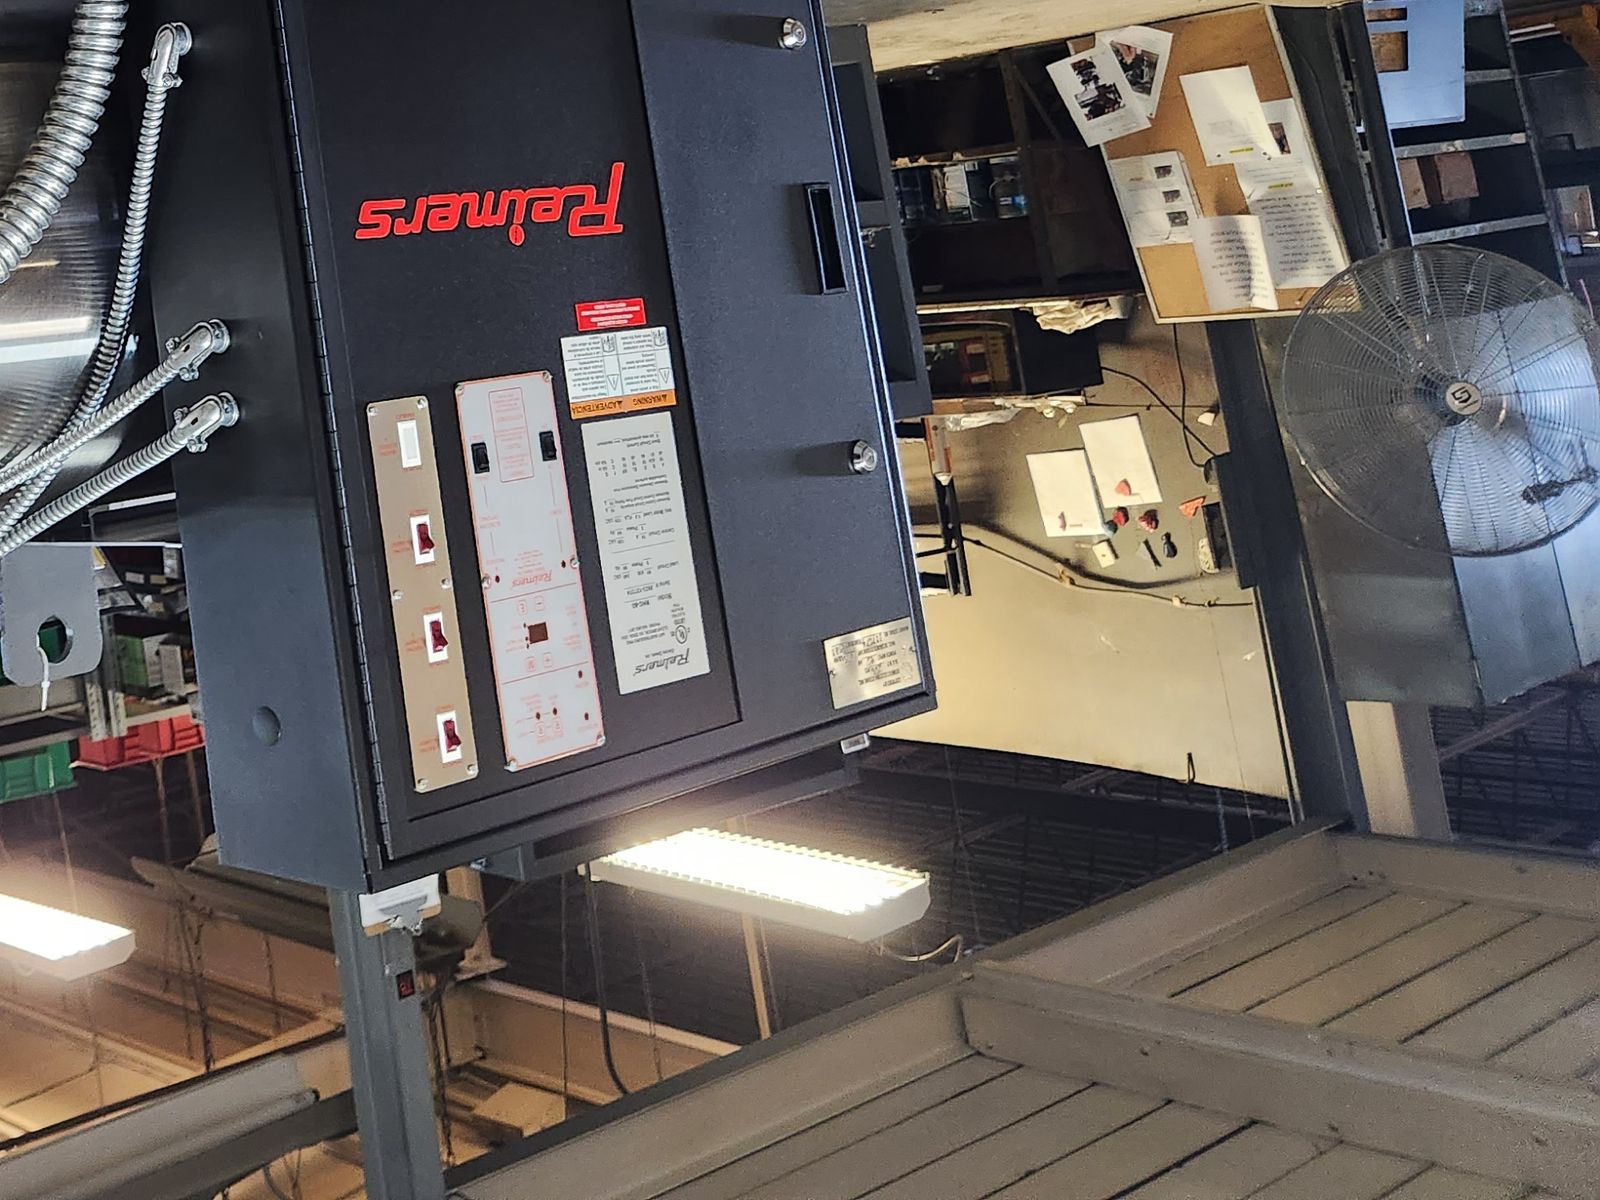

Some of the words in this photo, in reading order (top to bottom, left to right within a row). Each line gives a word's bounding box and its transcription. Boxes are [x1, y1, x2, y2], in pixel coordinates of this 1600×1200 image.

[354, 161, 625, 246] Reimers
[572, 401, 617, 415] ADVERTENCIA
[632, 395, 661, 406] WARNING
[635, 648, 690, 675] Reimers
